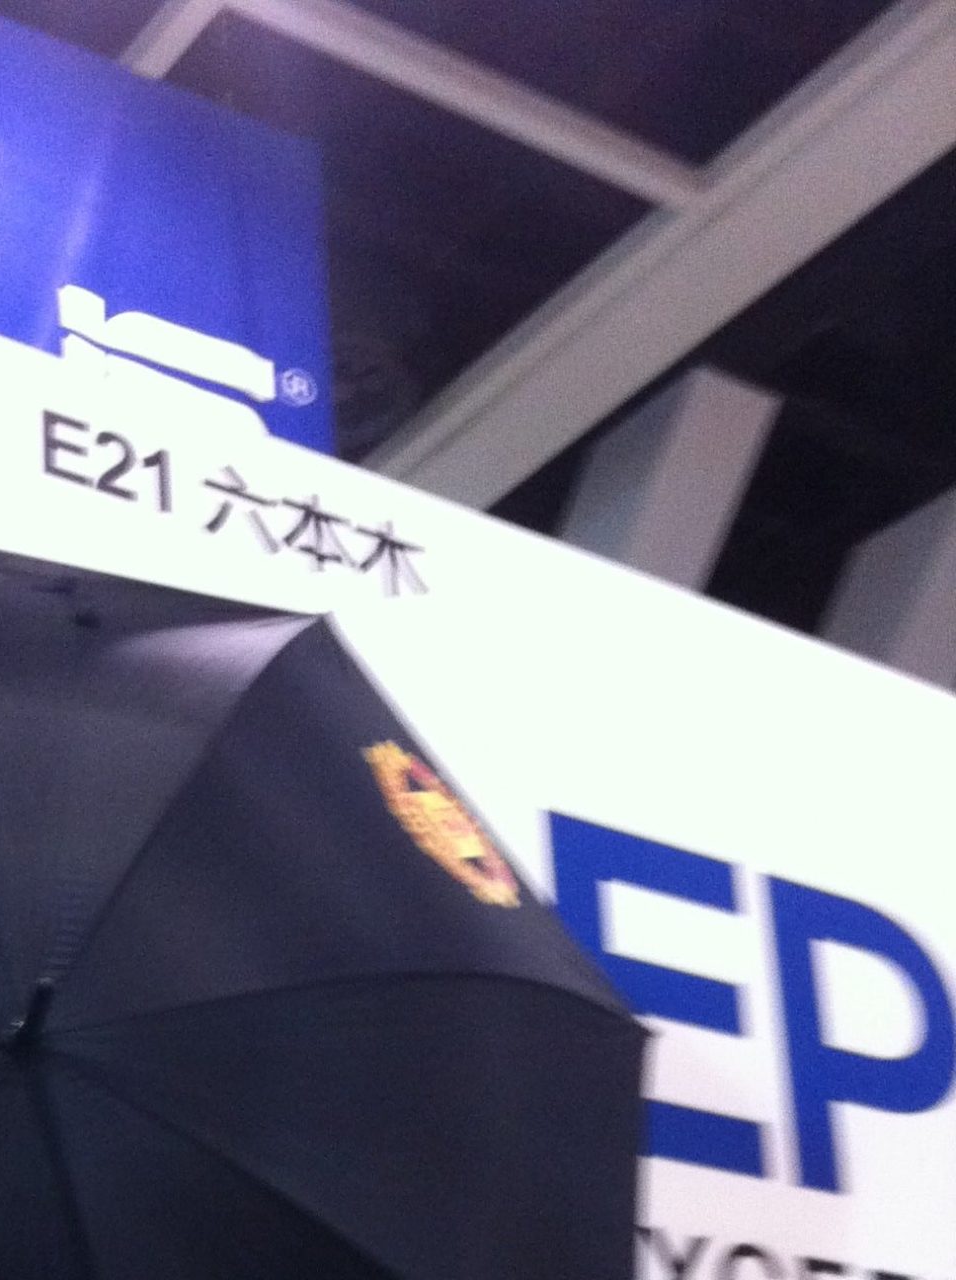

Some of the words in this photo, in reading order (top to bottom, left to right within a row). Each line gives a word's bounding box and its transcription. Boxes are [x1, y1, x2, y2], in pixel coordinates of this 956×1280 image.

[42, 408, 172, 514] E21
[201, 464, 430, 598] 六本木
